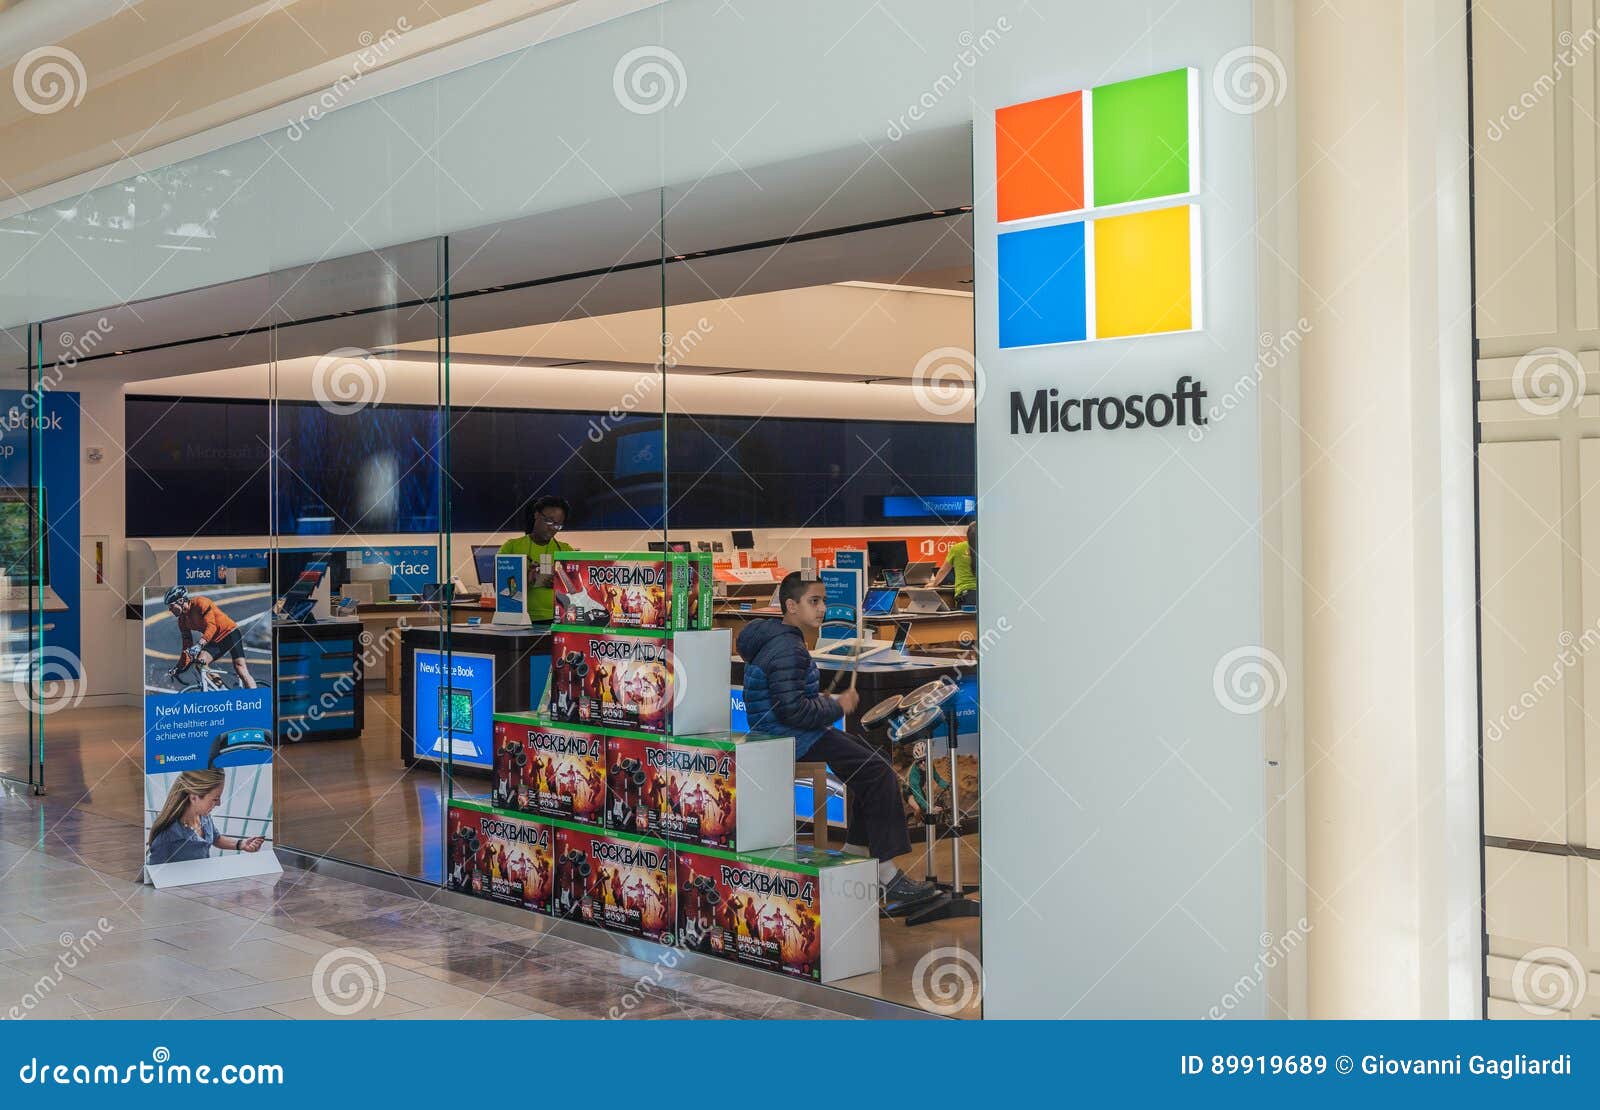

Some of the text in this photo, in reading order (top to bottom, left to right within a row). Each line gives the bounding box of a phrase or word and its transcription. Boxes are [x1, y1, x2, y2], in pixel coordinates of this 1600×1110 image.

[1010, 376, 1208, 434] Microsoft
[185, 567, 212, 579] Surface
[420, 661, 434, 673] New
[457, 665, 474, 677] Book
[155, 699, 262, 717] New Microsoft Band
[155, 717, 225, 730] Live healthier and
[155, 731, 187, 741] achieve
[166, 754, 196, 763] Microsoft
[589, 739, 600, 762] 4
[718, 756, 730, 781] 4
[540, 829, 549, 852] 4
[801, 882, 814, 907] 4
